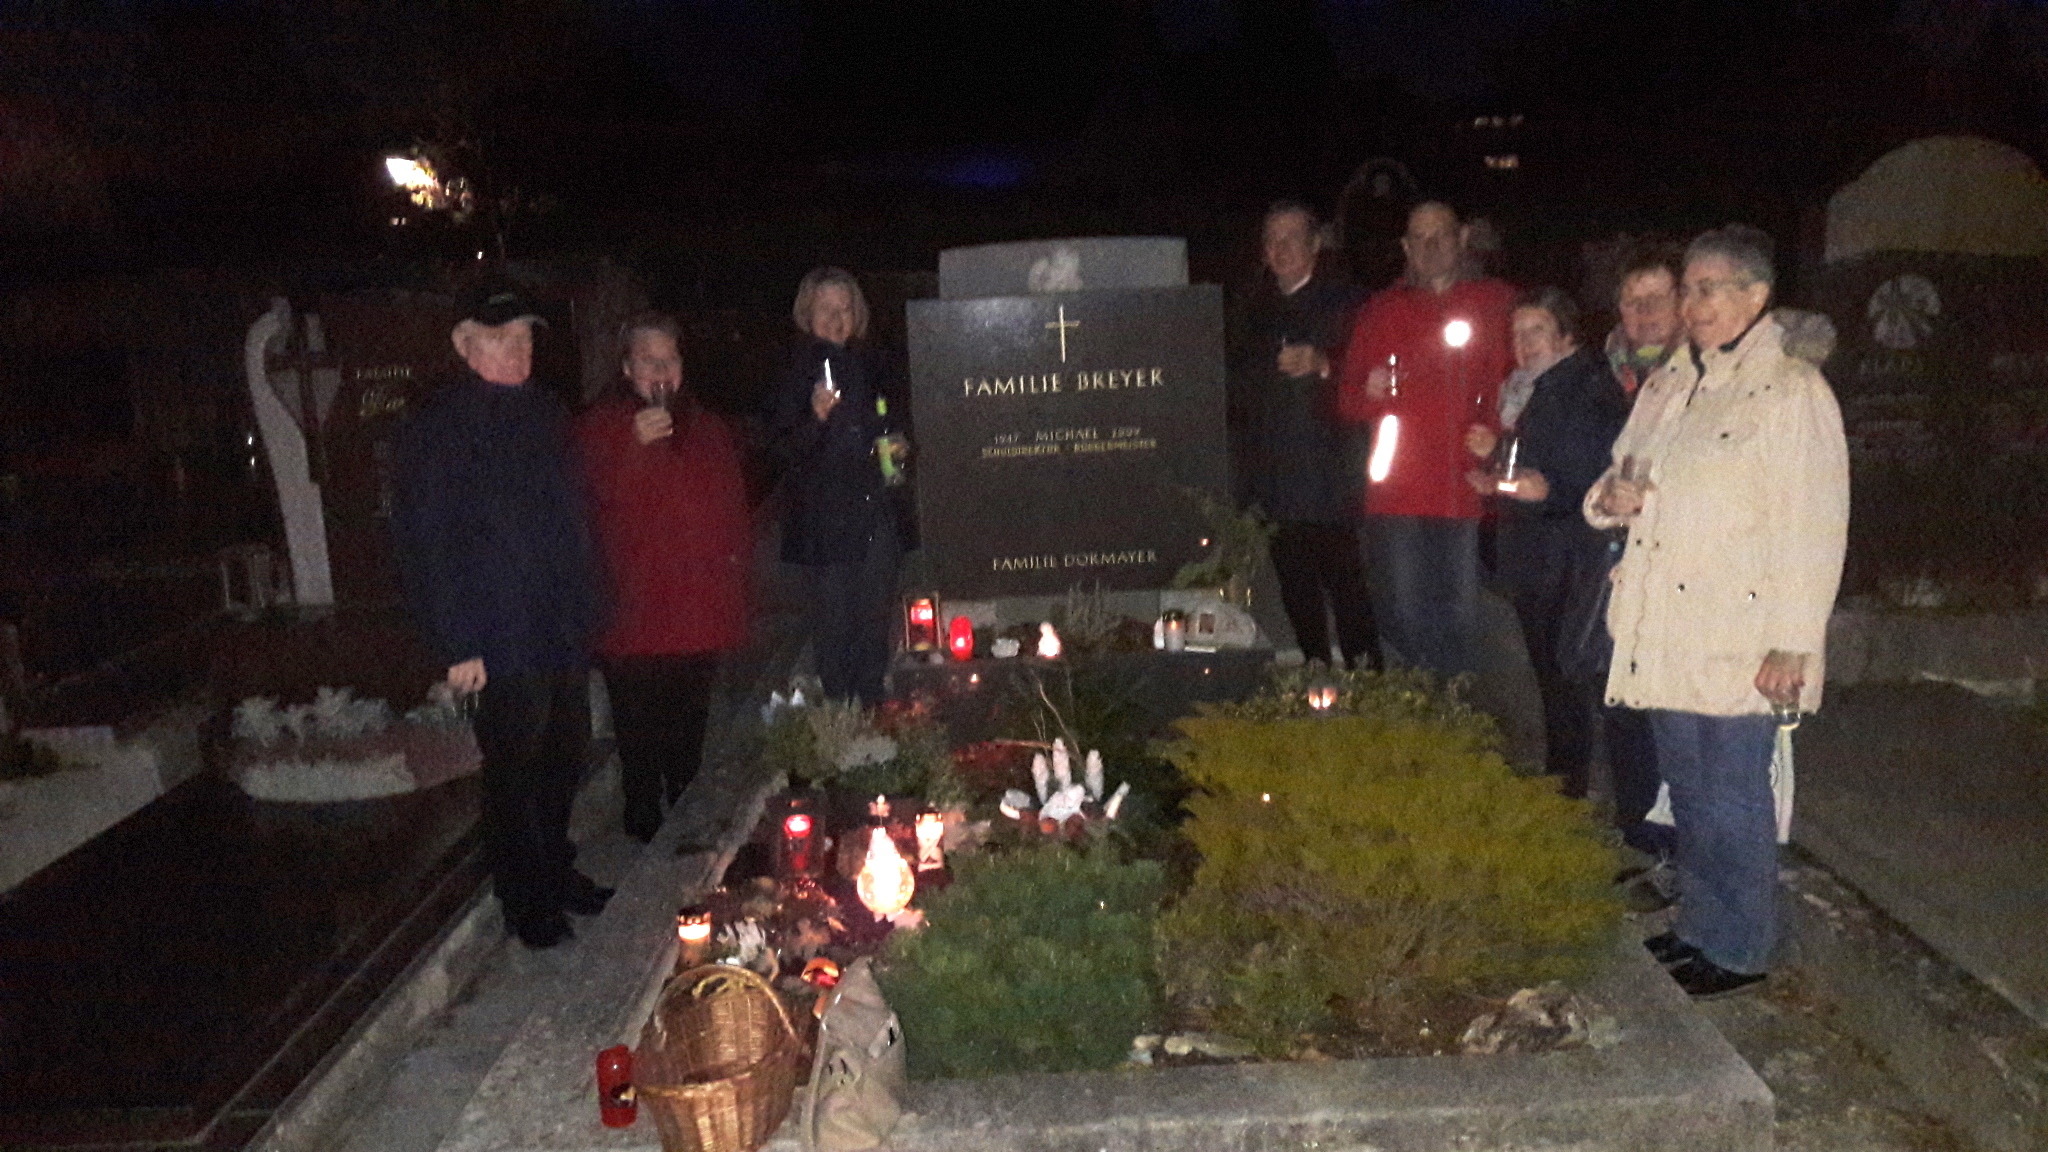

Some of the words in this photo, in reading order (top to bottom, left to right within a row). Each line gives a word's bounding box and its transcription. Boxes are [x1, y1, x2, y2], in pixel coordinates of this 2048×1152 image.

[964, 373, 1062, 397] FAMILIE
[1078, 367, 1164, 391] BREYER
[1036, 428, 1098, 442] MICHAEL
[993, 555, 1056, 571] FAMILIE
[1064, 549, 1157, 567] DORMAYER
